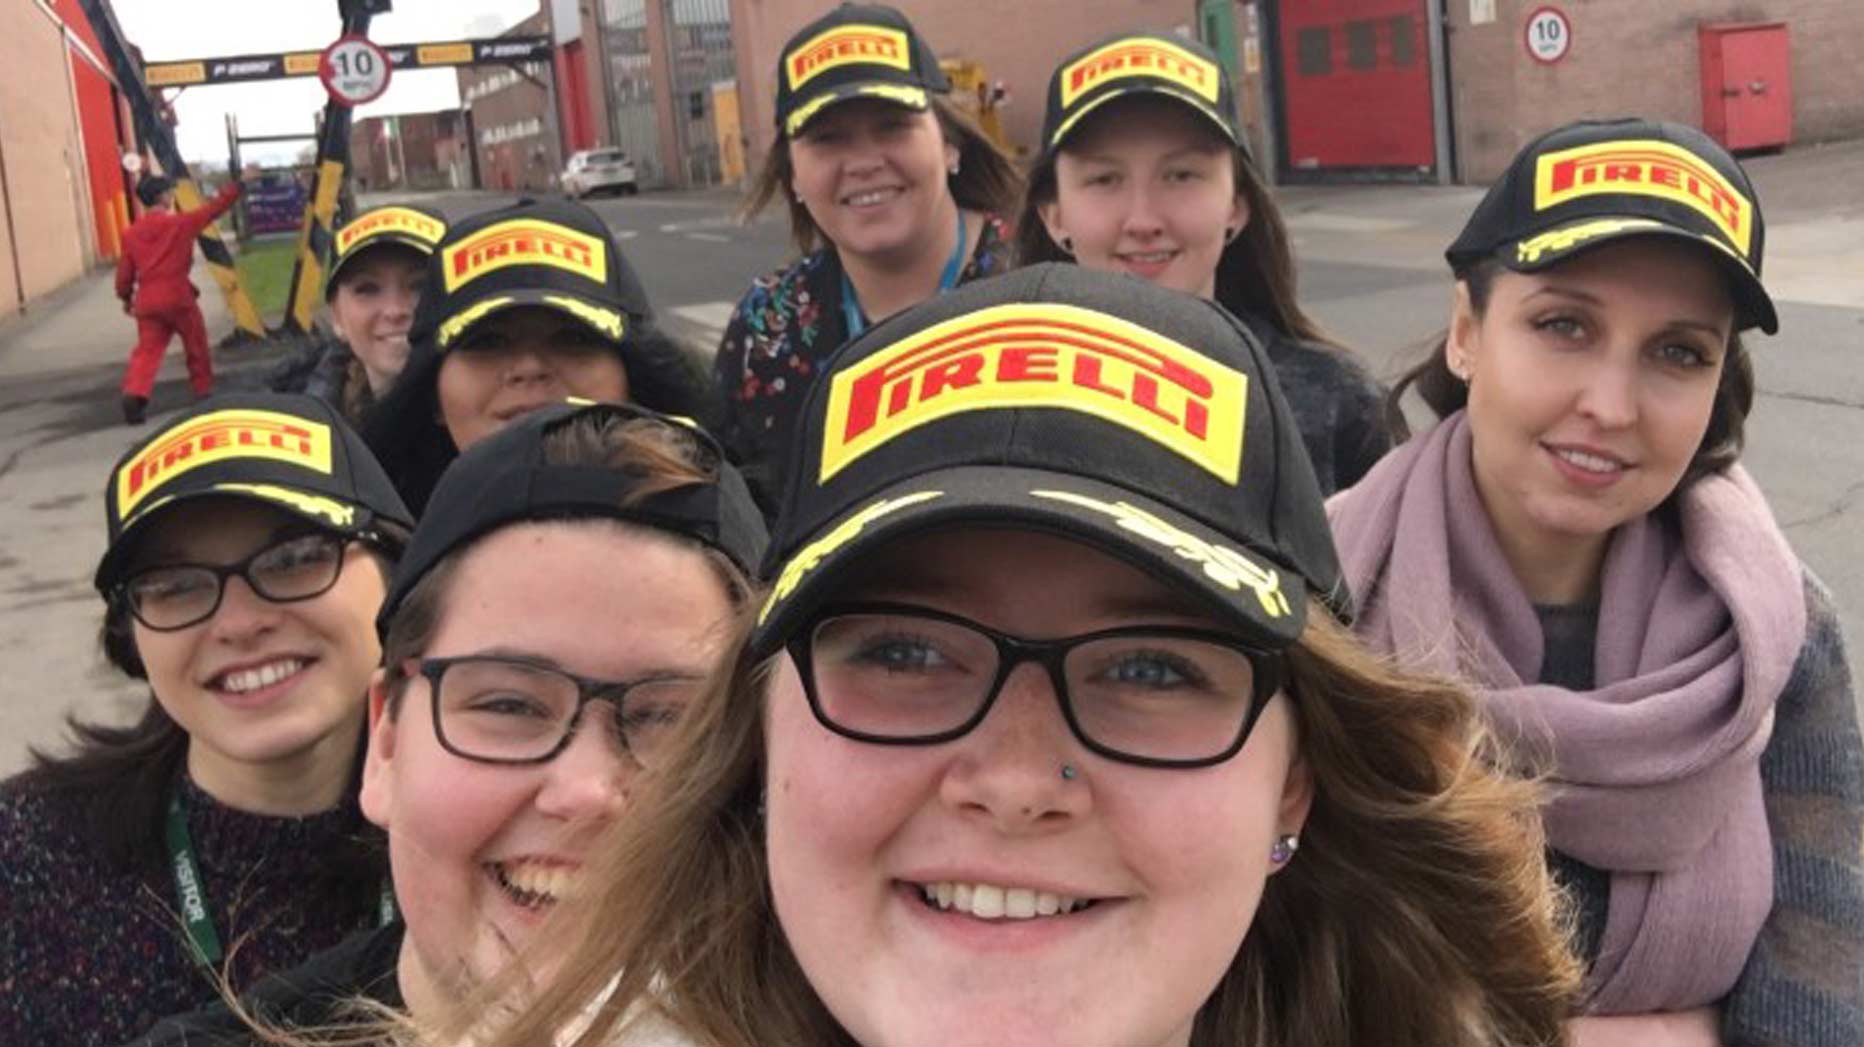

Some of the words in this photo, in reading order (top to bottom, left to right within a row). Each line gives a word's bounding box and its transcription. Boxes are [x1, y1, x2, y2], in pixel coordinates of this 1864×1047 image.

[1536, 20, 1561, 40] 10
[335, 50, 372, 75] 10
[793, 34, 898, 82] PIRELLI
[1071, 45, 1205, 92] PIRELLI
[1551, 150, 1740, 233] PIRELLI
[342, 212, 437, 245] PIRELLI
[453, 227, 592, 277] PIRELLI
[843, 318, 1214, 445] PIRELLI
[129, 418, 311, 497] PIRELLI
[175, 850, 205, 923] VISITOR
